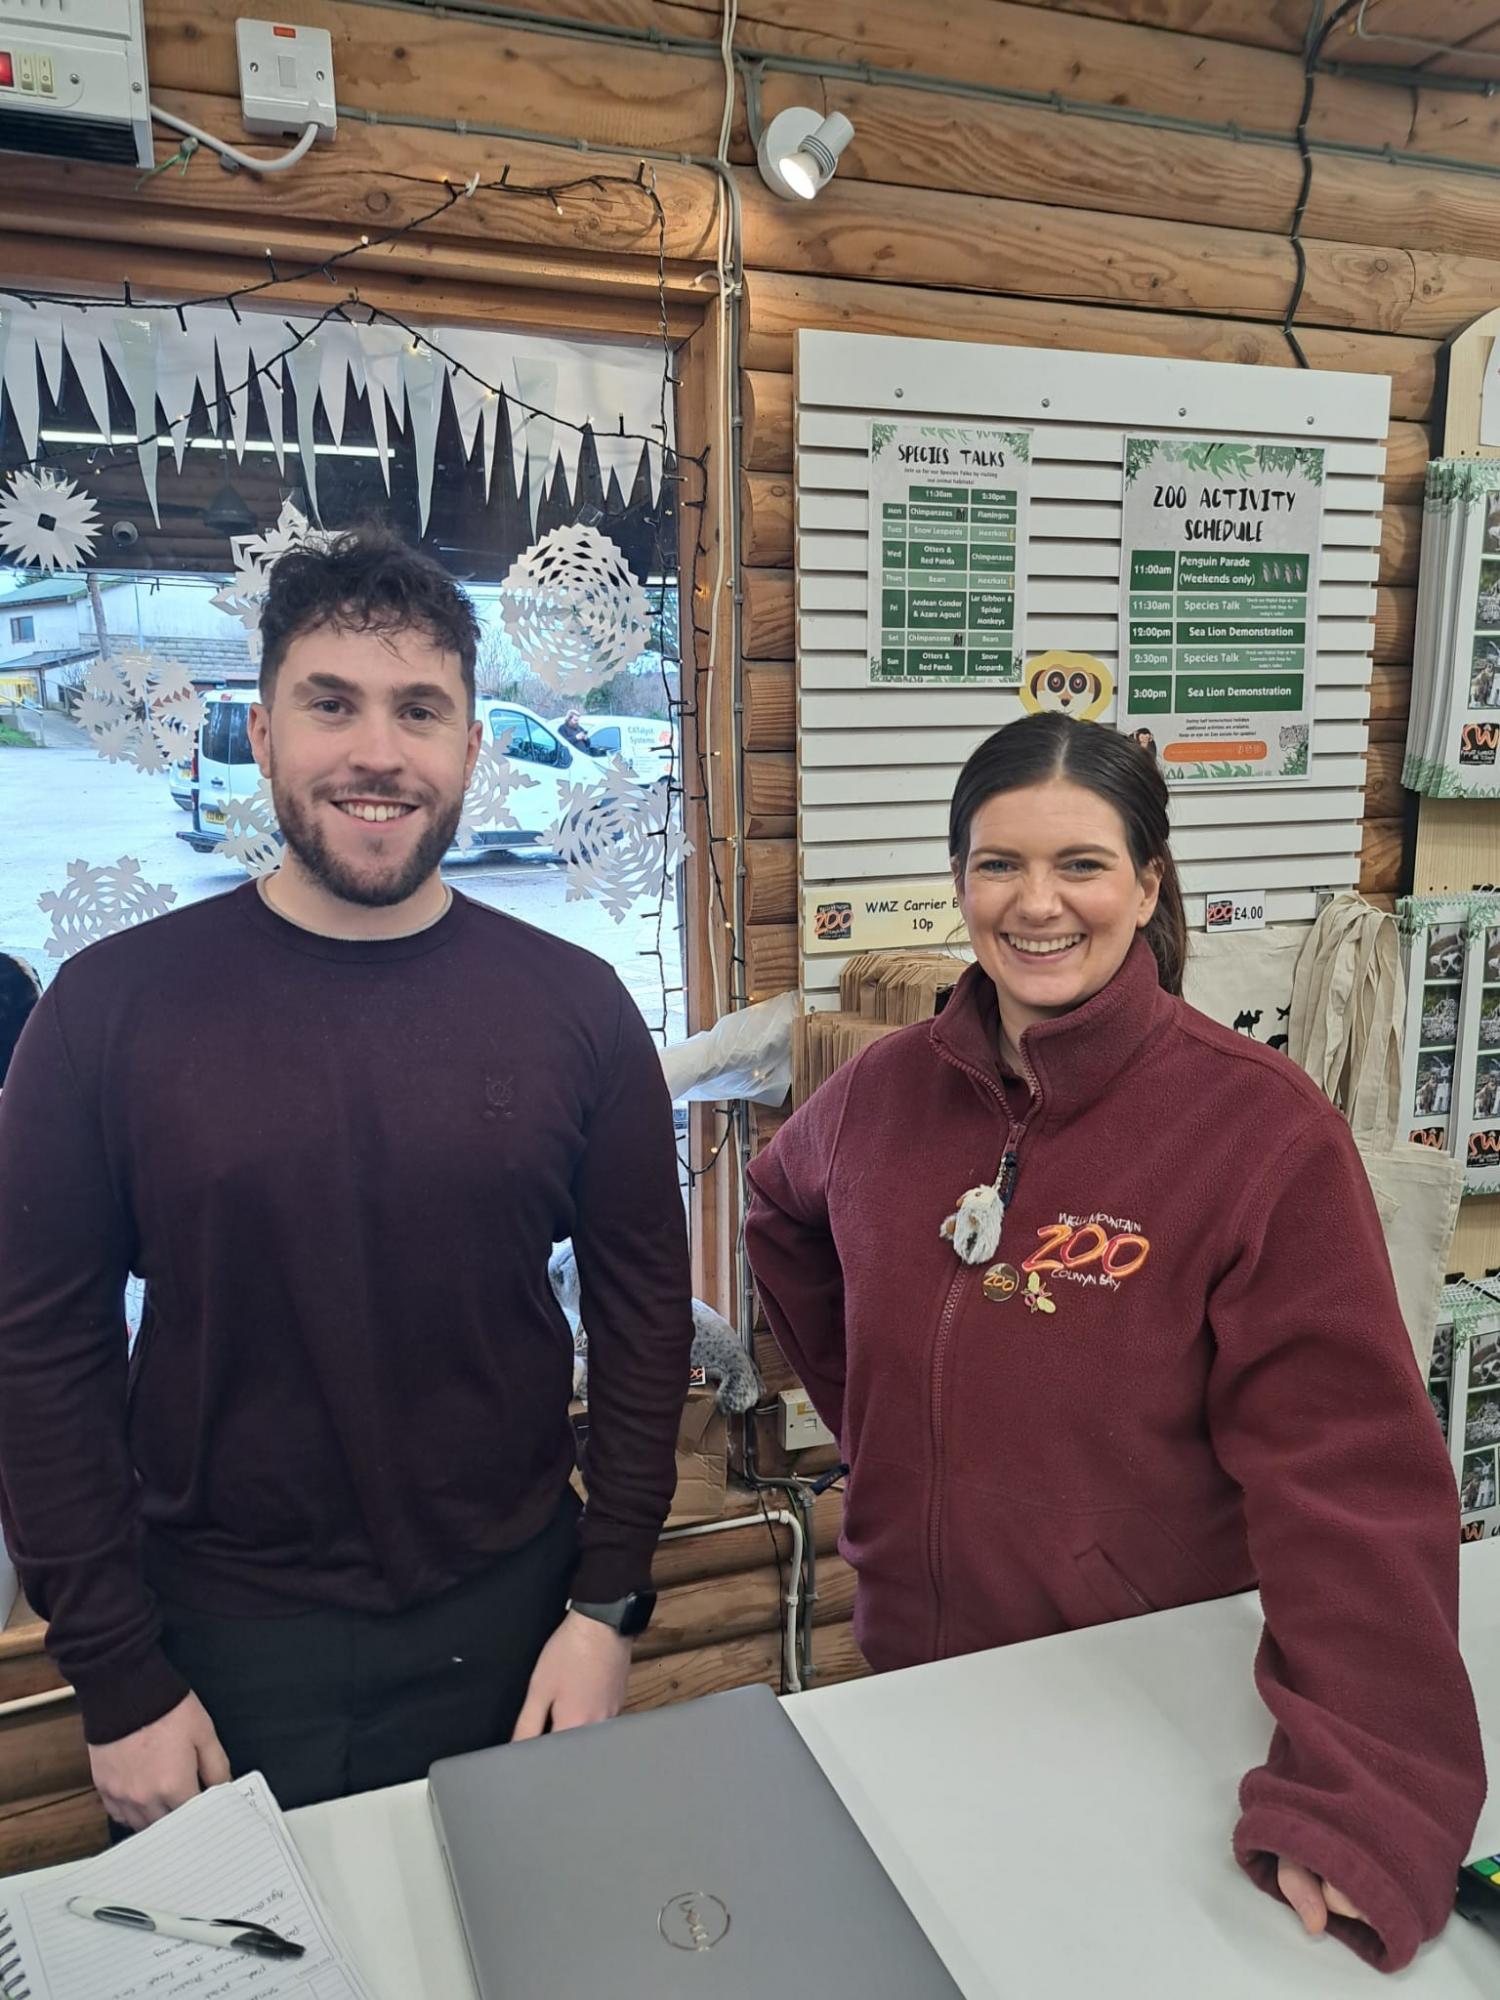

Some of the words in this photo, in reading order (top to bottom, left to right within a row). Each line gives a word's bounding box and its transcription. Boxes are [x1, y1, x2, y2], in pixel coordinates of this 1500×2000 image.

[898, 444, 949, 465] SPECIES
[960, 450, 1005, 468] TALKS
[925, 490, 952, 498] 11:30am
[982, 492, 1006, 501] 2:30pm
[1153, 485, 1187, 509] ZOO
[1200, 488, 1296, 512] ACTIVITY
[910, 508, 953, 517] Chimpanzees
[977, 511, 1010, 520] Flamingos
[914, 526, 932, 534] Snow
[933, 527, 963, 536] Leopards
[978, 529, 1007, 537] Meerkats
[1184, 519, 1264, 542] SCHEDULE
[887, 550, 902, 558] Wed
[923, 545, 945, 553] Otters
[946, 546, 952, 554] &
[935, 557, 955, 565] Panda
[971, 553, 1014, 562] Chimpanzees
[1180, 556, 1217, 567] Penguin
[1220, 557, 1250, 567] Parade
[1134, 565, 1172, 574] 11:00am
[978, 577, 1007, 585] Meerkats
[1179, 572, 1230, 585] (Weekends
[1232, 573, 1256, 587] only)
[912, 599, 937, 607] Andean
[1132, 601, 1170, 610] 11:30am
[1184, 601, 1219, 612] Species
[1222, 600, 1240, 610] Talk
[939, 611, 961, 619] Agouti
[981, 606, 1002, 614] Spider
[977, 617, 1005, 626] Monkeys
[1132, 627, 1171, 638] 12:00pm
[1189, 626, 1206, 637] Sea
[1208, 626, 1227, 637] Lion
[1230, 626, 1294, 637] Demonstration
[908, 634, 951, 642] Chimpanzees
[1134, 653, 1168, 664] 2:30pm
[1183, 653, 1219, 664] Species
[1221, 652, 1239, 662] Talk
[919, 663, 932, 671] Red
[933, 663, 953, 671] Panda
[975, 663, 1004, 673] Leopards
[1133, 688, 1167, 699] 3:00pm
[1187, 687, 1204, 697] Sea
[1206, 687, 1225, 697] Lion
[1227, 685, 1292, 697] Demonstration
[865, 900, 899, 913] WMZ
[903, 899, 947, 911] Carrier
[1234, 905, 1263, 920] £4.00
[815, 911, 855, 935] ZOO
[912, 918, 934, 932] 10p
[1089, 1211, 1142, 1232] MOUNTAIN
[1021, 1223, 1151, 1278] ZOO
[983, 1272, 1016, 1292] ZOO
[1050, 1268, 1097, 1287] COLWYN
[1099, 1273, 1121, 1292] BAY
